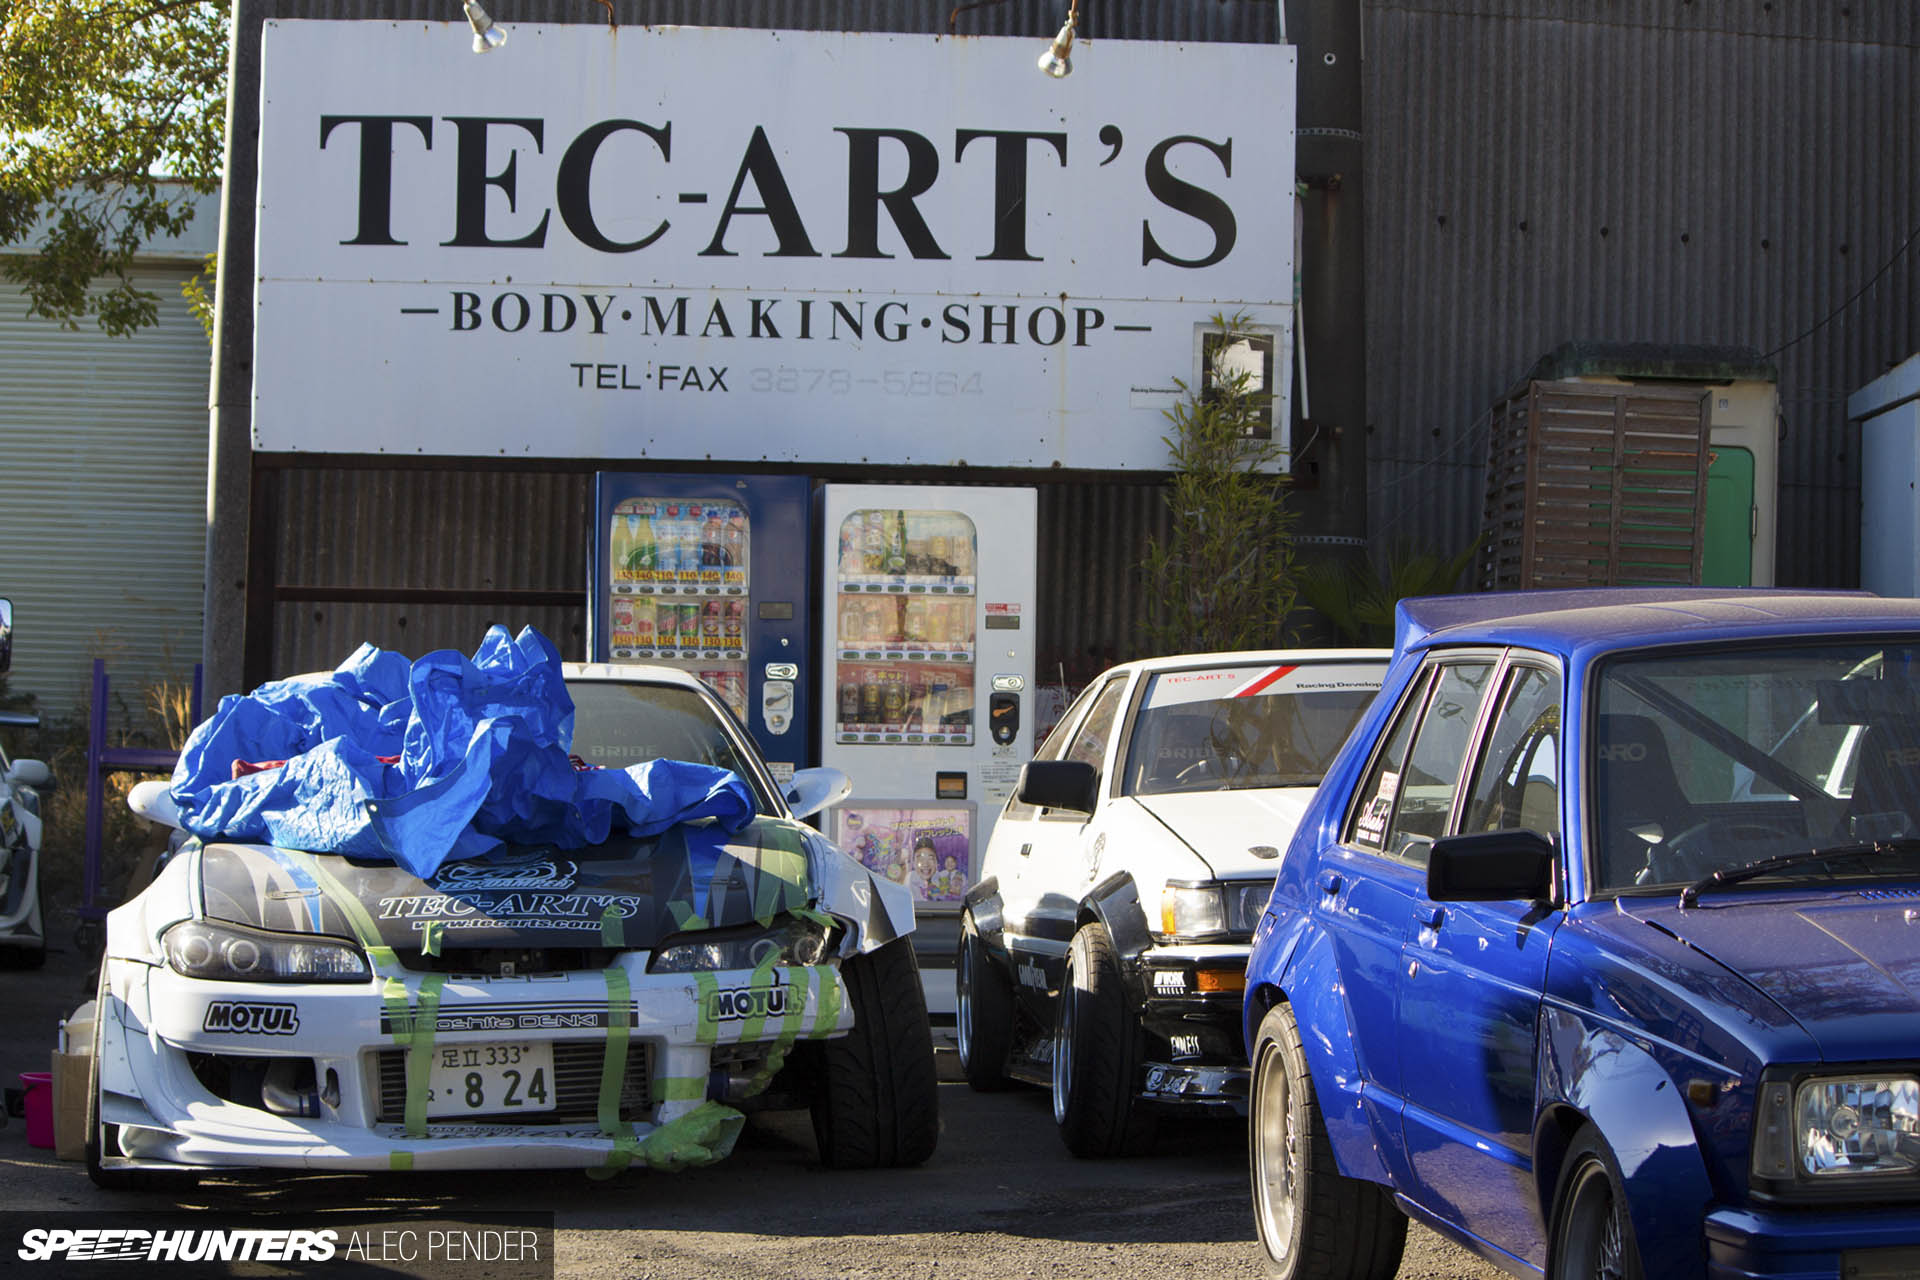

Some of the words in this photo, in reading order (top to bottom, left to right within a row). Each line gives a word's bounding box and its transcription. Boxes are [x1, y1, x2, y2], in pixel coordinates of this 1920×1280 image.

[320, 115, 1237, 268] TEC-ART'S
[378, 893, 641, 919] TEC-ART'S
[205, 1002, 299, 1034] MOTUL
[519, 1013, 598, 1029] DENKI
